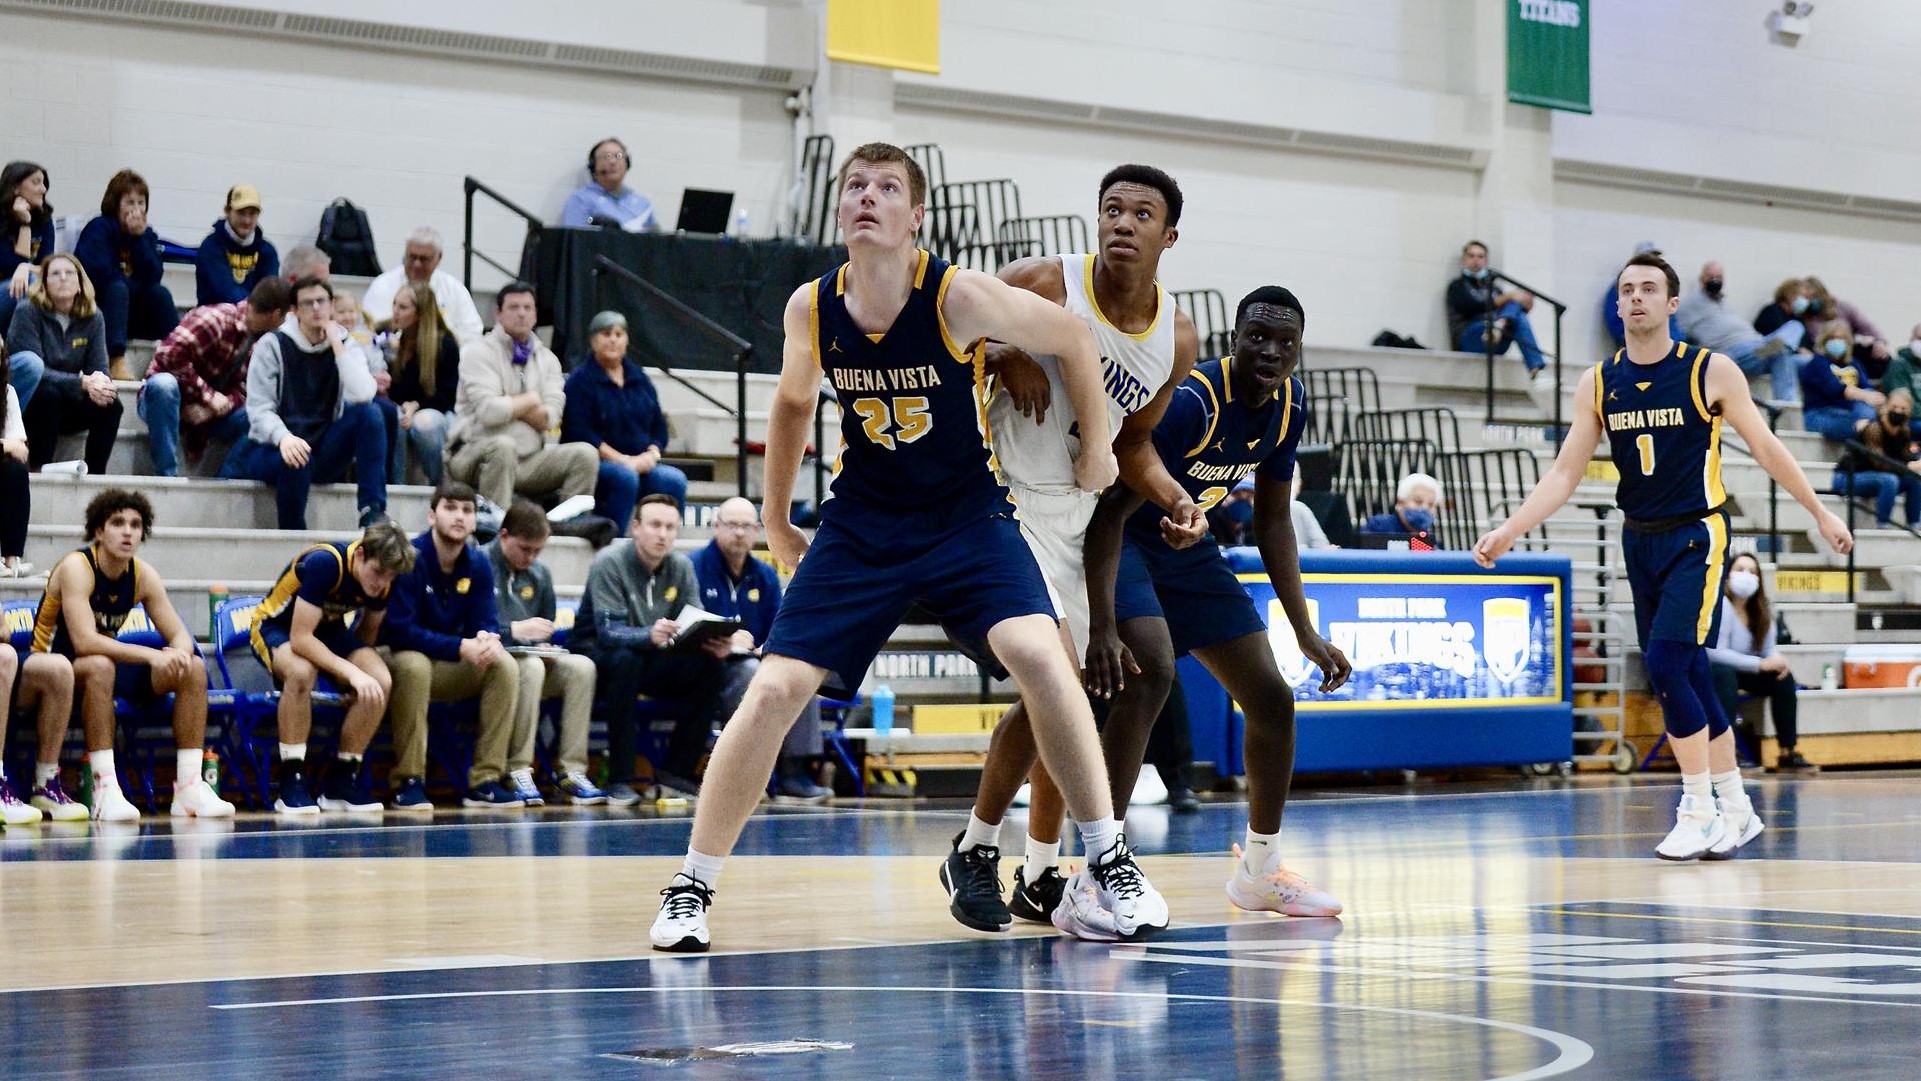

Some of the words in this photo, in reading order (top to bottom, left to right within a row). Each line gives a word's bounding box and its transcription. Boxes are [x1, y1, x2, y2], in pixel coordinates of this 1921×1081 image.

[1518, 0, 1581, 28] TITANS
[833, 367, 888, 392] BUENA
[887, 364, 942, 390] VISTA
[1100, 356, 1150, 416] INGS
[852, 396, 933, 450] 25
[1608, 410, 1646, 431] BUENA
[1646, 407, 1684, 427] VISTA
[1635, 433, 1655, 476] 1
[1186, 460, 1235, 481] BUENA
[1329, 622, 1475, 678] VIKINGS
[874, 654, 930, 678] NORTH
